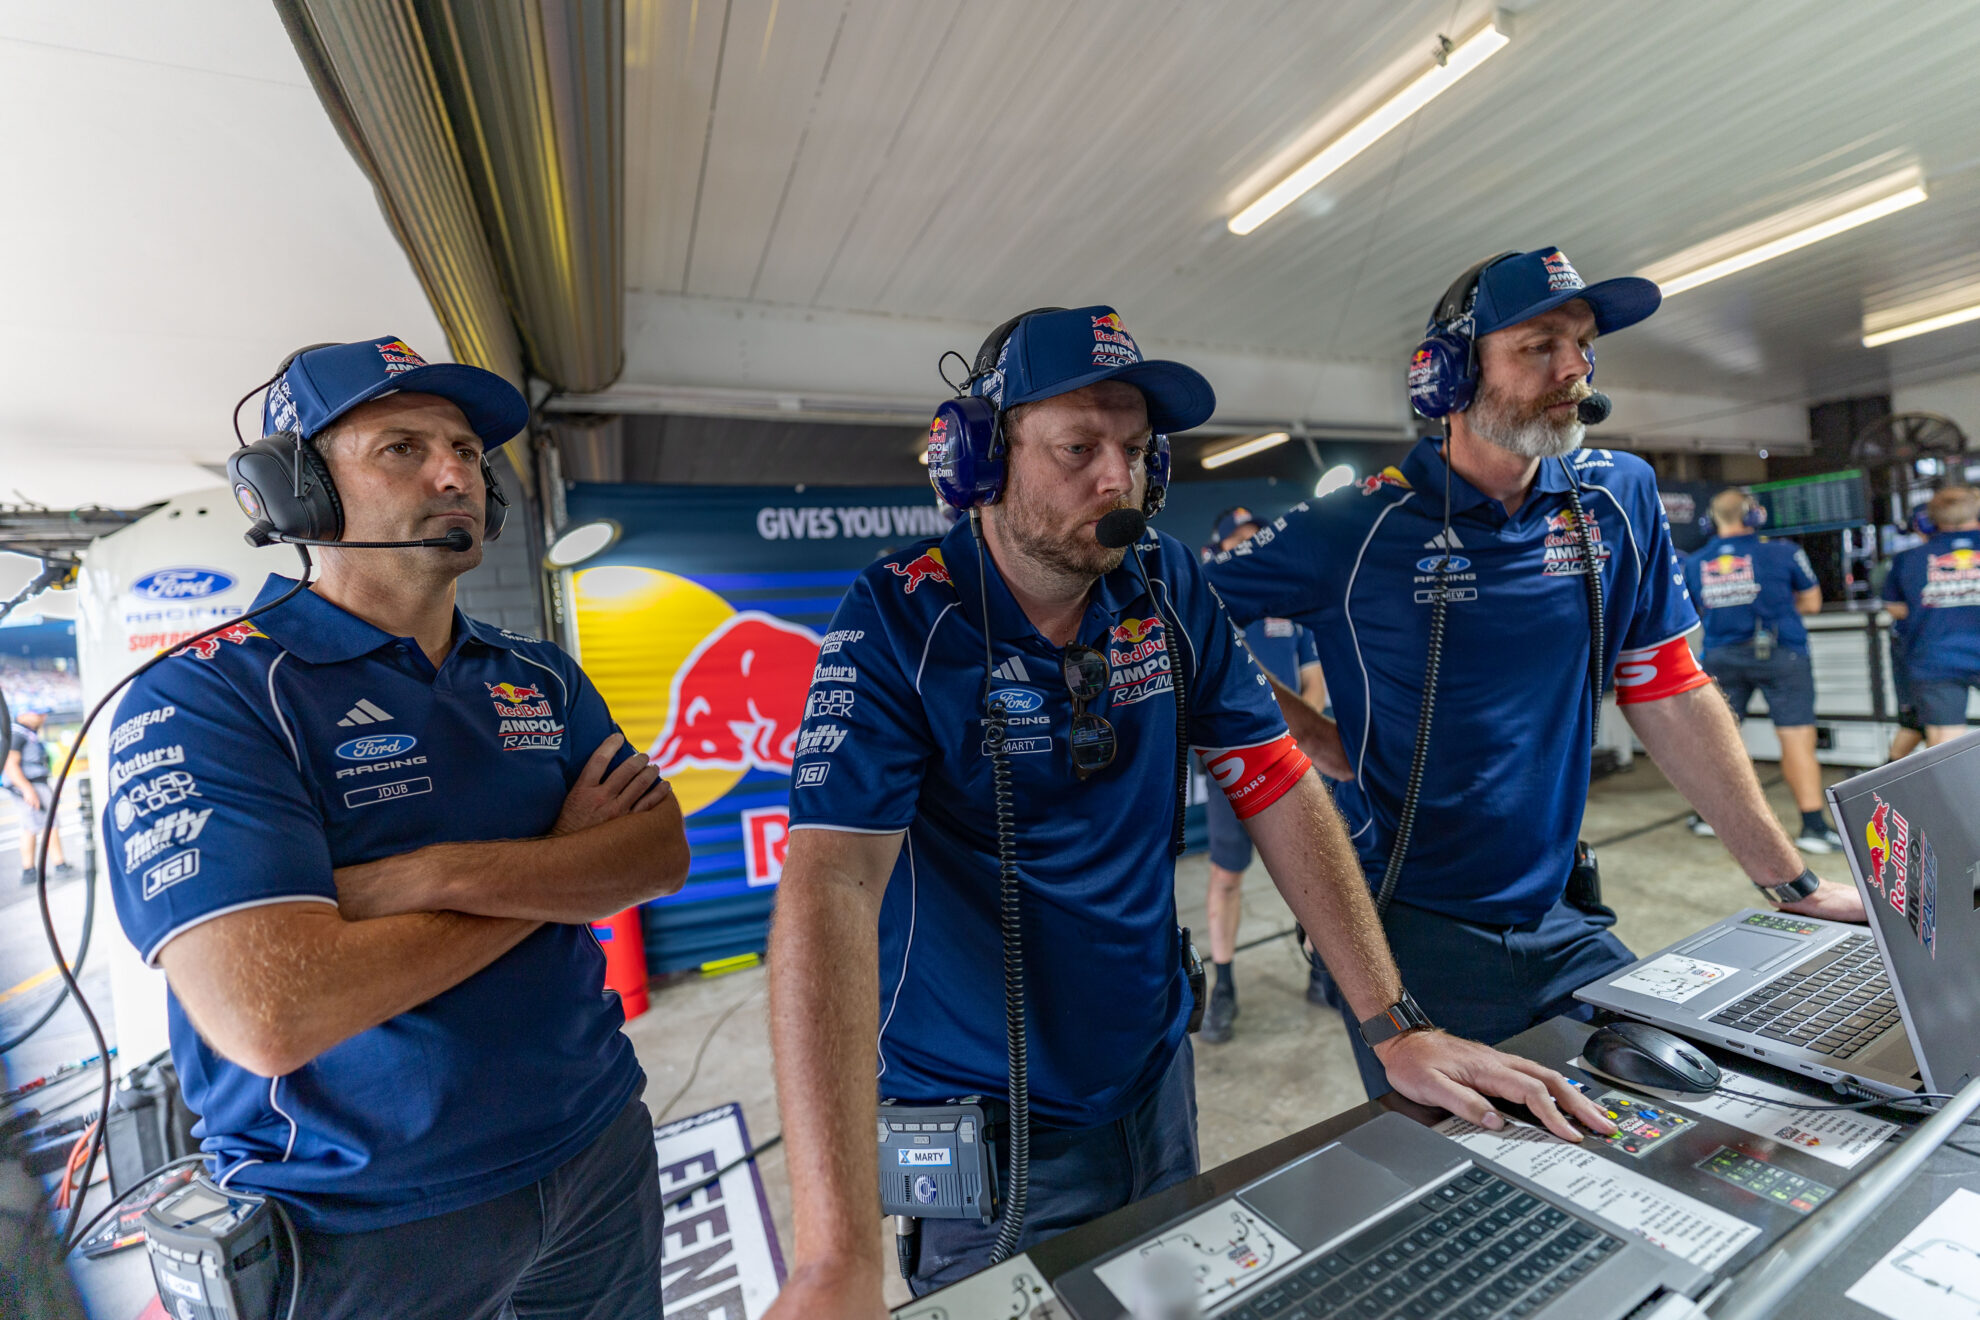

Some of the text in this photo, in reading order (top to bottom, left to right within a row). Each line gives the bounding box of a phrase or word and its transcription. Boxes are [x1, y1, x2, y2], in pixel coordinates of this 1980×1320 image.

[1094, 330, 1119, 343] Red
[1094, 355, 1132, 365] RACI
[757, 507, 837, 540] GIVES
[837, 507, 892, 538] YOU
[1136, 544, 1160, 552] POL
[1544, 558, 1606, 573] RACI
[147, 571, 215, 597] Ford
[126, 605, 243, 624] RACING
[128, 630, 200, 652] SUPERC
[1111, 632, 1167, 668] Red Bul
[1109, 655, 1171, 687] AMPO
[813, 690, 854, 703] QUAD
[996, 692, 1033, 709] Ford
[494, 700, 553, 717] Red Bull
[812, 704, 853, 718] LOCK
[499, 720, 564, 733] AMPOL
[981, 716, 1051, 726] RCING
[353, 738, 401, 757] Ford
[503, 733, 563, 747] RACING
[1002, 741, 1035, 751] MARTY
[336, 756, 428, 779] RACING
[130, 771, 193, 802] QUAD
[378, 784, 408, 798] JDUB
[1227, 773, 1266, 800] RCARS
[133, 783, 203, 817] LOCK
[1890, 809, 1909, 917] Red Bull
[147, 853, 193, 894] JGI
[914, 1152, 944, 1161] MARTY
